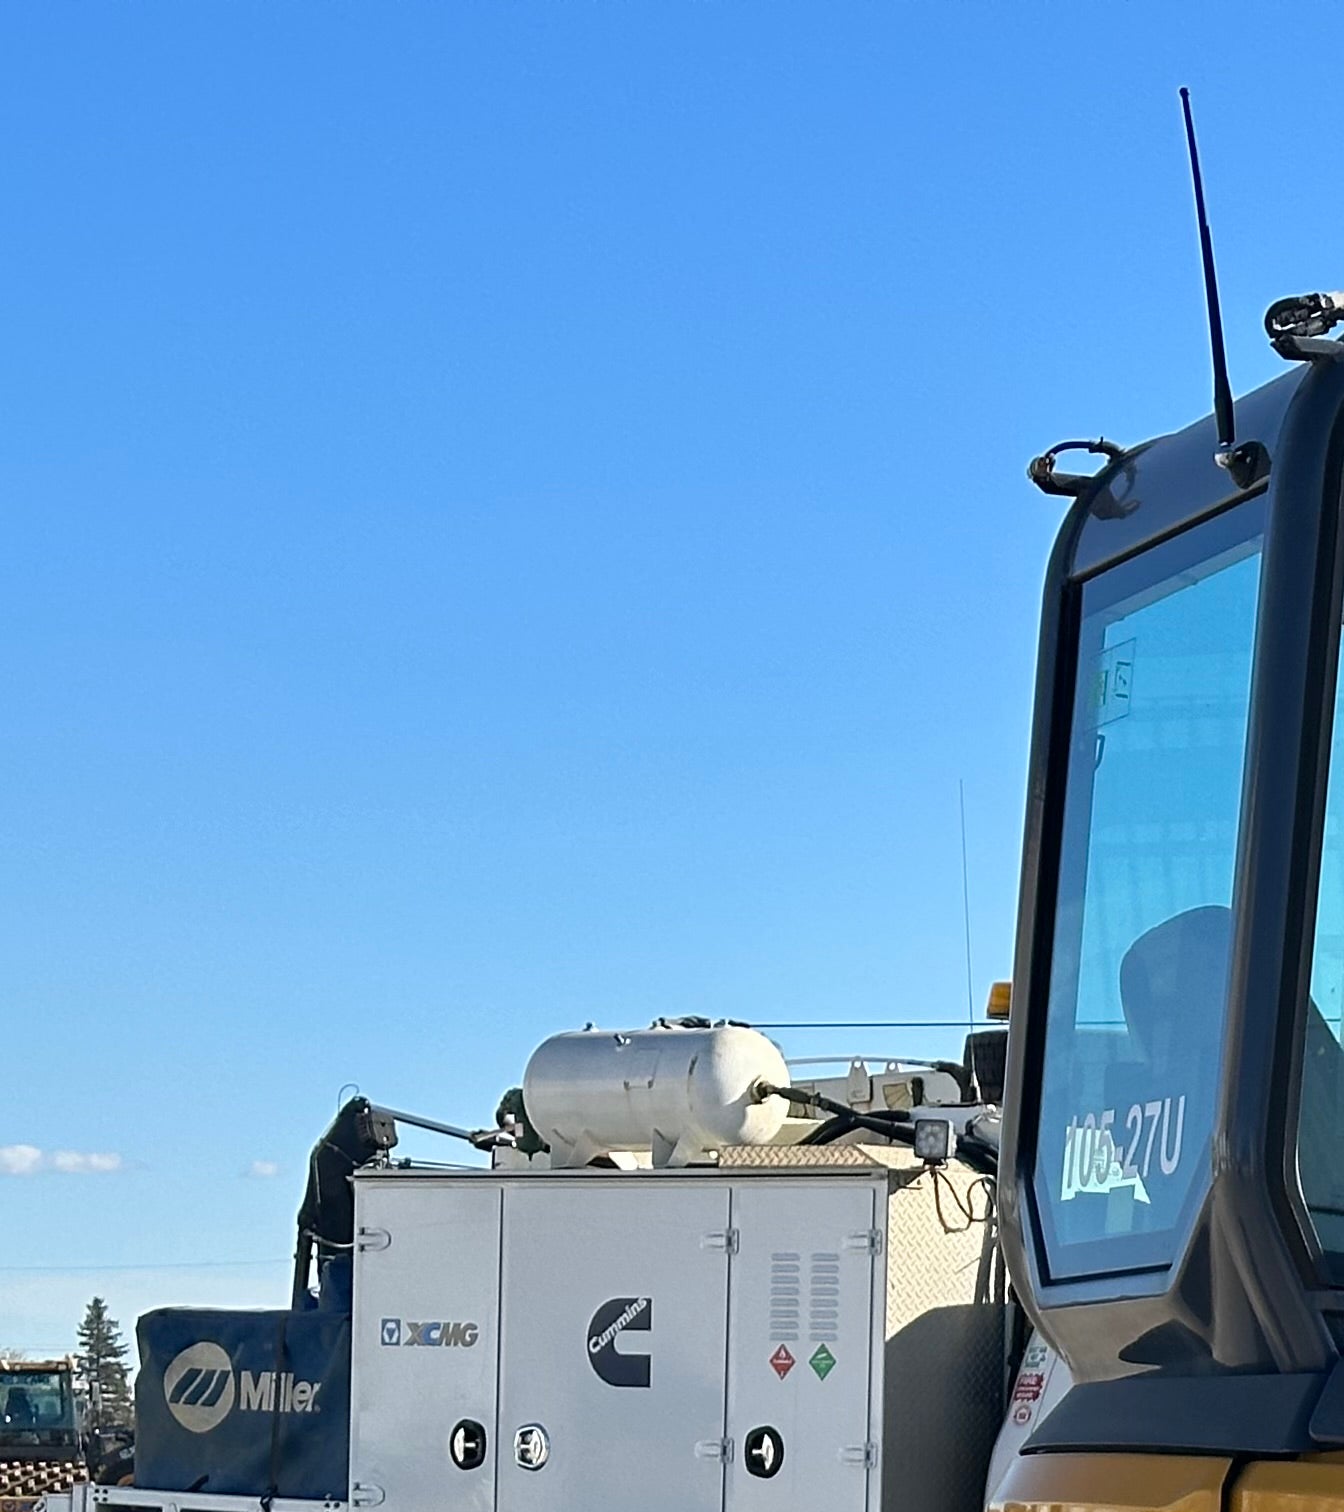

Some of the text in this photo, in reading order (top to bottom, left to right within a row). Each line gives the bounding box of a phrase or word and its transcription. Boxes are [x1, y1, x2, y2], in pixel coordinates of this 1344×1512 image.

[403, 1321, 479, 1347] XCMG
[588, 1297, 648, 1353] Cummins
[239, 1370, 322, 1413] Miller
